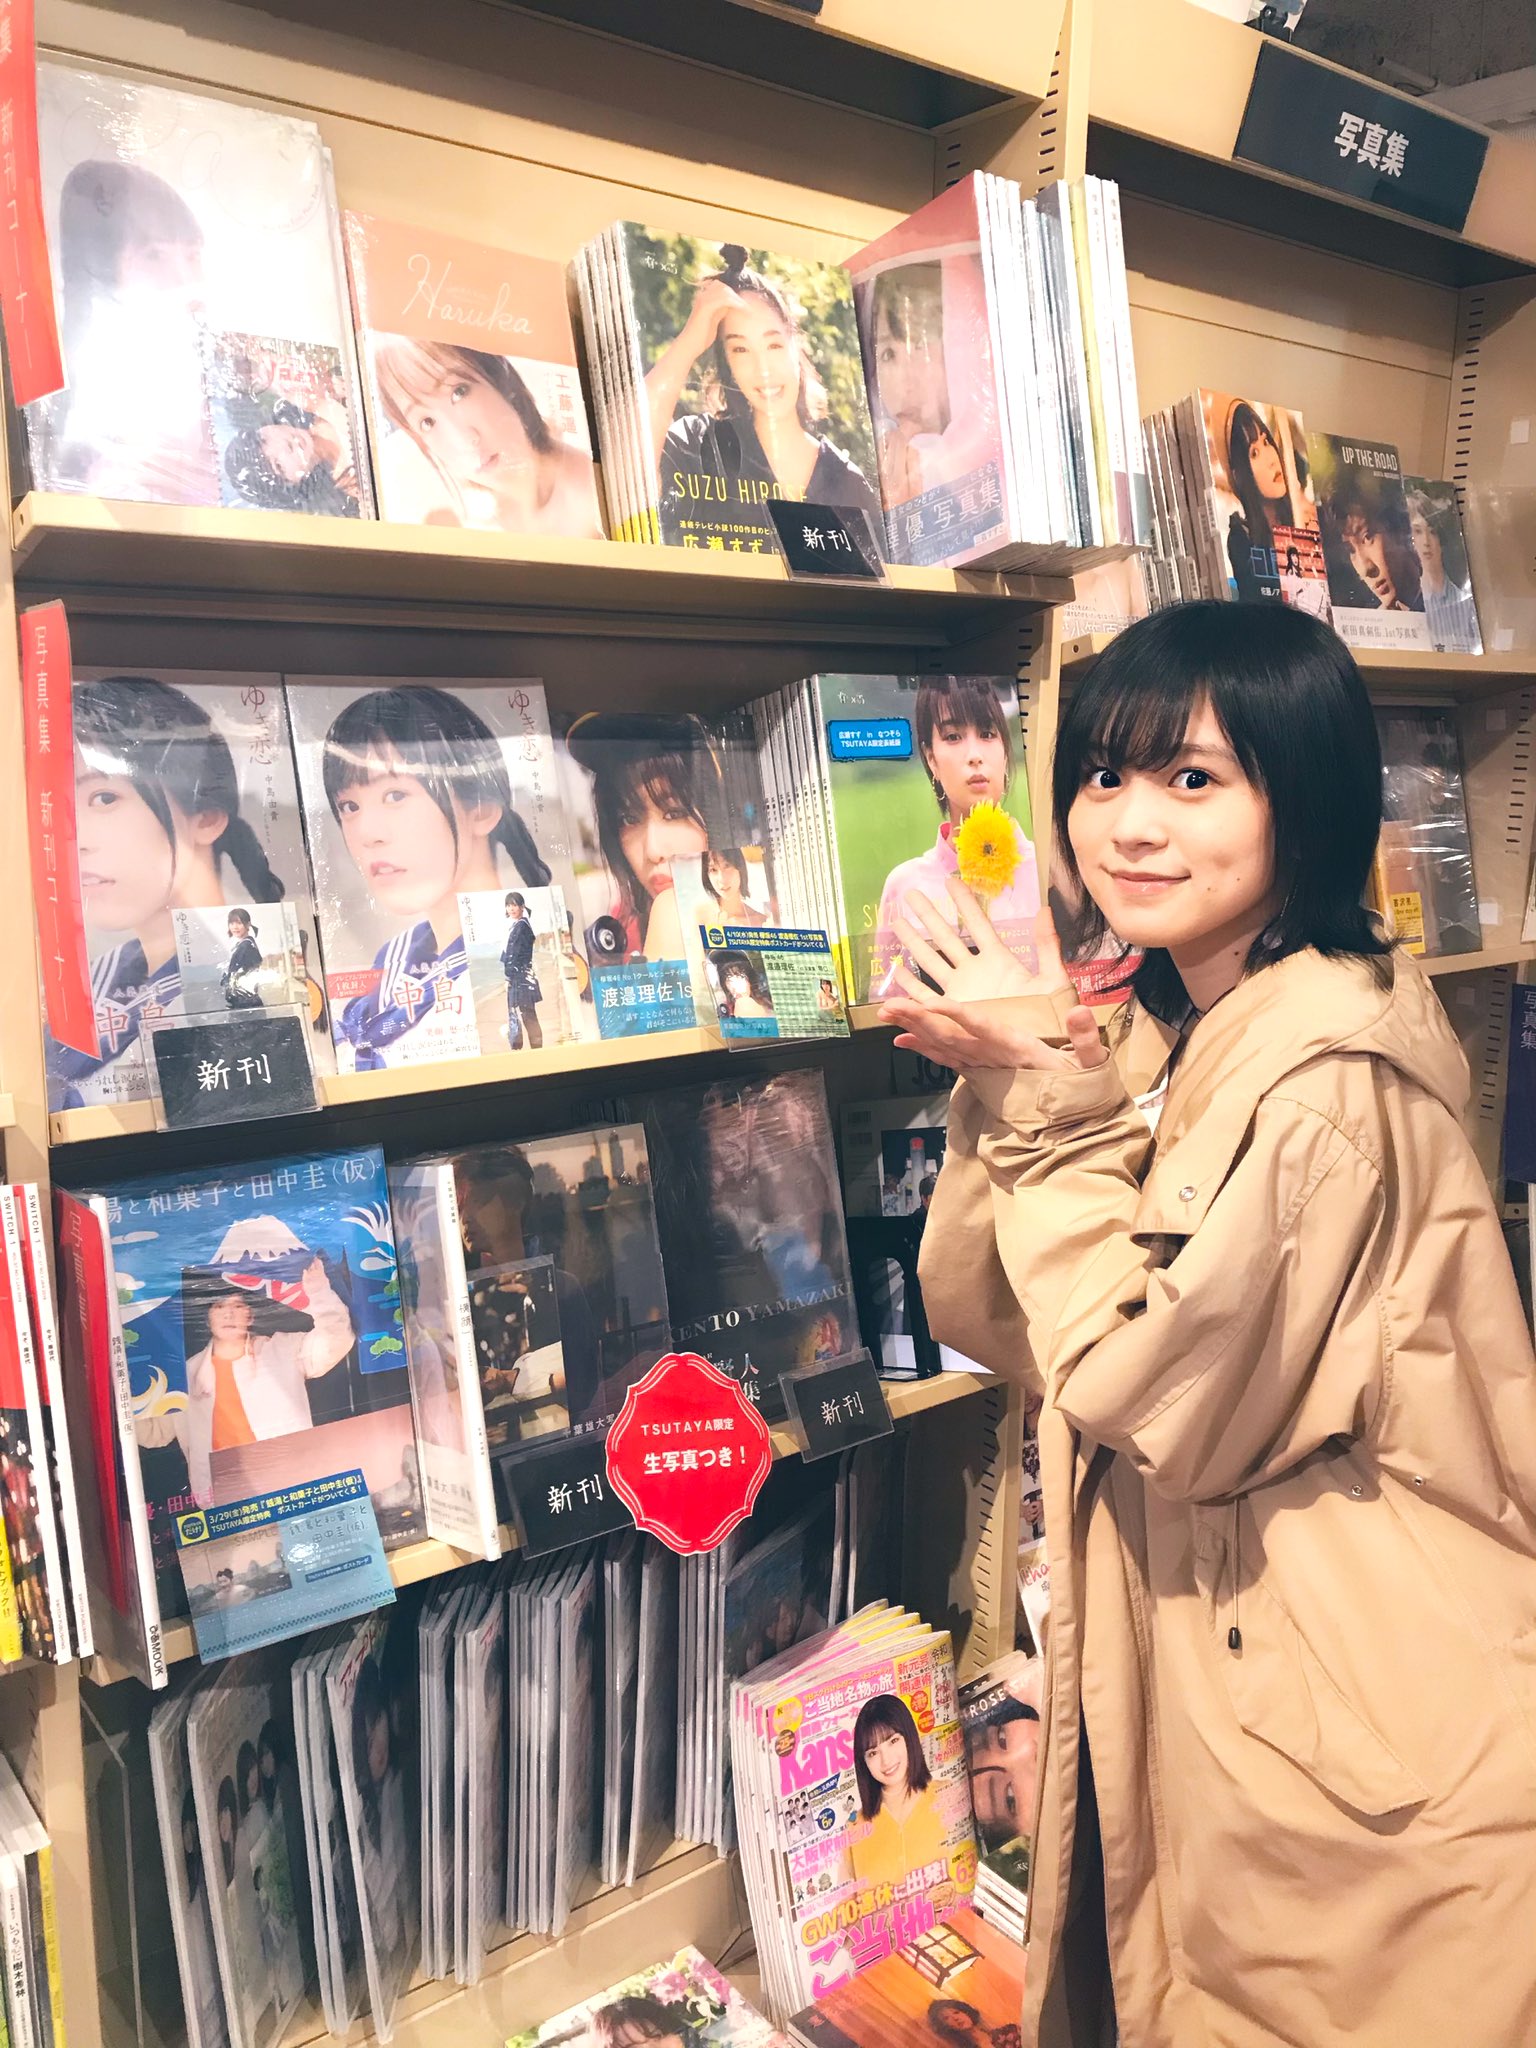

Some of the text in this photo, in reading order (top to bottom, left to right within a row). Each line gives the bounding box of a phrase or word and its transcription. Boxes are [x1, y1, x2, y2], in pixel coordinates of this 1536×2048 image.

[1334, 111, 1409, 178] 写真集
[402, 253, 534, 335] Haruka
[1342, 446, 1398, 471] UP THE ROAD
[673, 471, 727, 502] SUZU
[933, 478, 1001, 529] 写真集
[683, 534, 764, 554] 広瀬すず
[802, 525, 852, 552] 新刊
[34, 626, 52, 754] 写真集
[264, 774, 279, 821] 中島由貴
[393, 976, 463, 1024] 中島
[601, 981, 675, 1008] 渡邊理佐
[97, 1002, 176, 1054] 中島
[197, 1053, 272, 1092] 新刊
[4, 1195, 15, 1235] SWITCH
[29, 1194, 40, 1234] SWITCH
[641, 1418, 735, 1437] TSUTAYA限定
[821, 1391, 865, 1426] 新刊
[643, 1445, 747, 1475] 生写真つき!
[547, 1473, 604, 1515] 新刊
[149, 1624, 164, 1677] ぴあMOOK
[898, 1653, 930, 1675] 新元号
[931, 1643, 948, 1661] 令和
[804, 1673, 895, 1719] ご当地名物の旅
[801, 1862, 948, 1947] GW10連休に出発!
